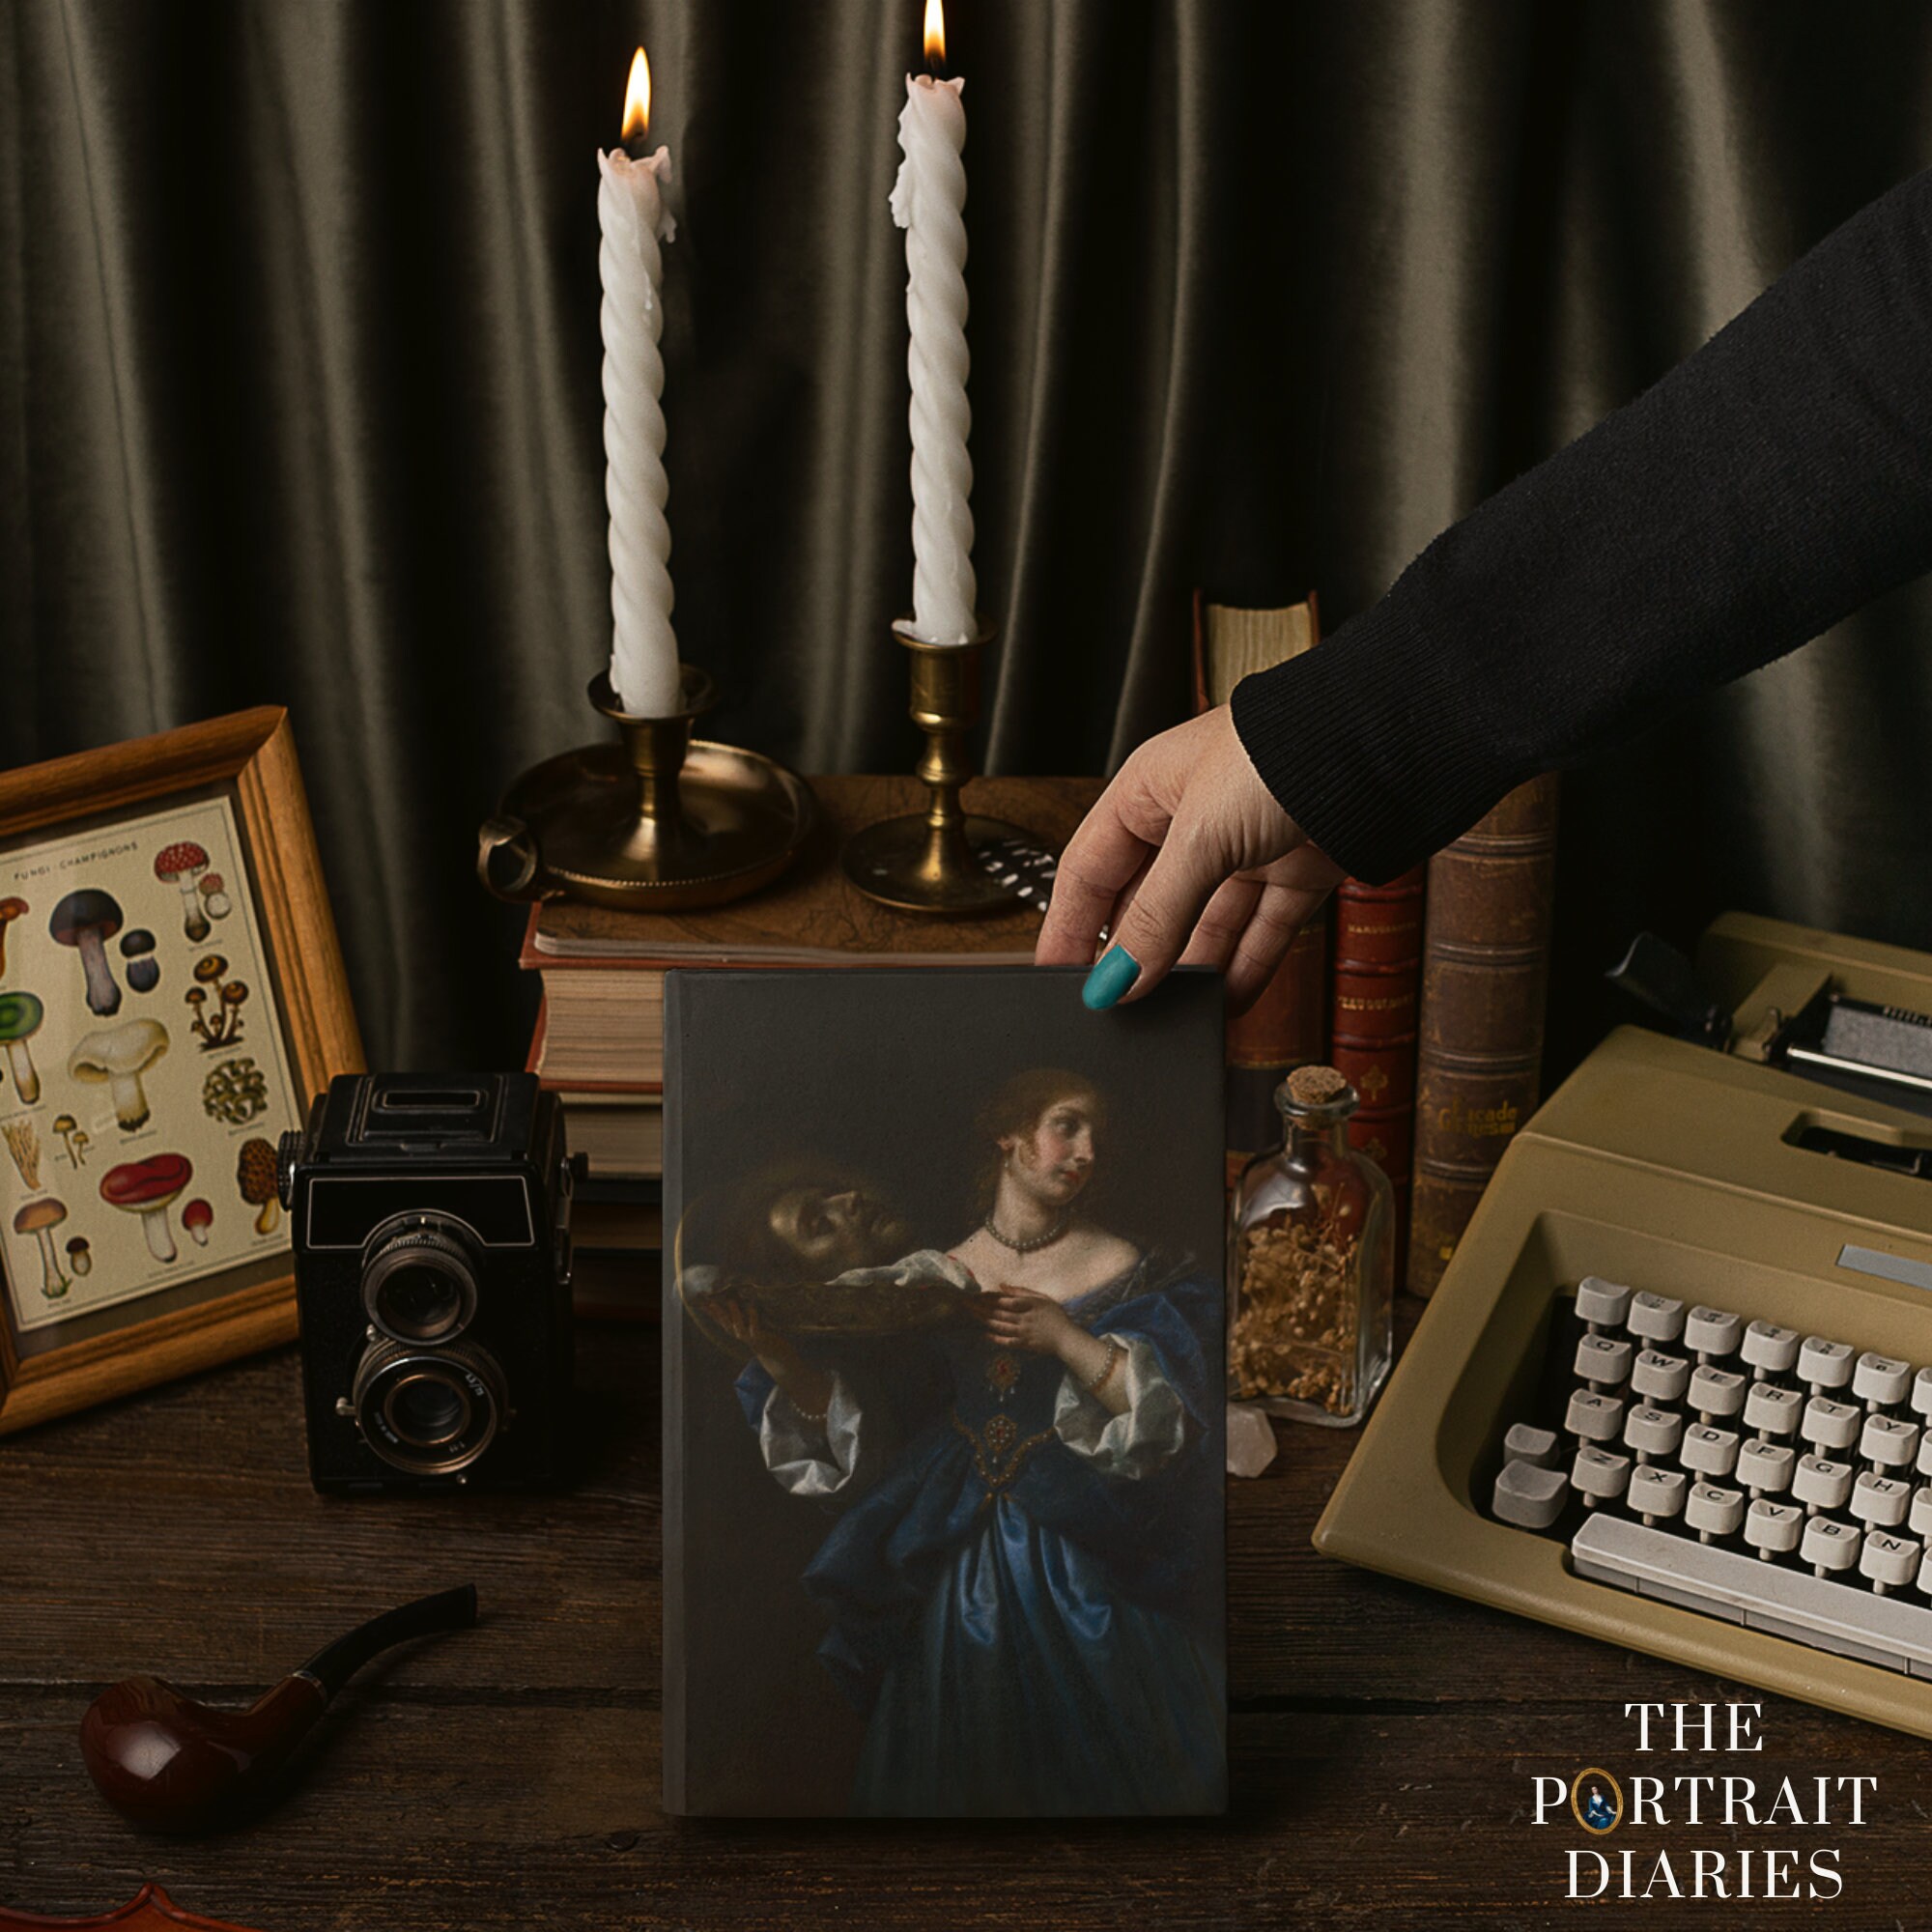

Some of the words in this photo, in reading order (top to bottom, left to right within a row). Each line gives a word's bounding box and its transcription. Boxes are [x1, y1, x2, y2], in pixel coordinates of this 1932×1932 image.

[14, 866, 50, 881] FUNGI
[59, 841, 138, 868] CHAMPIGNONS
[1596, 1339, 1614, 1351] Q
[1651, 1354, 1674, 1367] W
[1709, 1373, 1727, 1382] E
[1765, 1389, 1784, 1401] R
[1826, 1404, 1843, 1413] T
[1886, 1420, 1902, 1431] Y
[1586, 1398, 1603, 1407] A
[1645, 1411, 1662, 1421] S
[1701, 1430, 1720, 1441] D
[1756, 1446, 1776, 1455] F
[1814, 1463, 1833, 1473] G
[1873, 1480, 1893, 1492] H
[1593, 1454, 1611, 1463] Z
[1649, 1471, 1667, 1483] X
[1706, 1491, 1724, 1500] C
[1769, 1506, 1785, 1517] V
[1822, 1524, 1841, 1536] B
[1881, 1539, 1901, 1550] N
